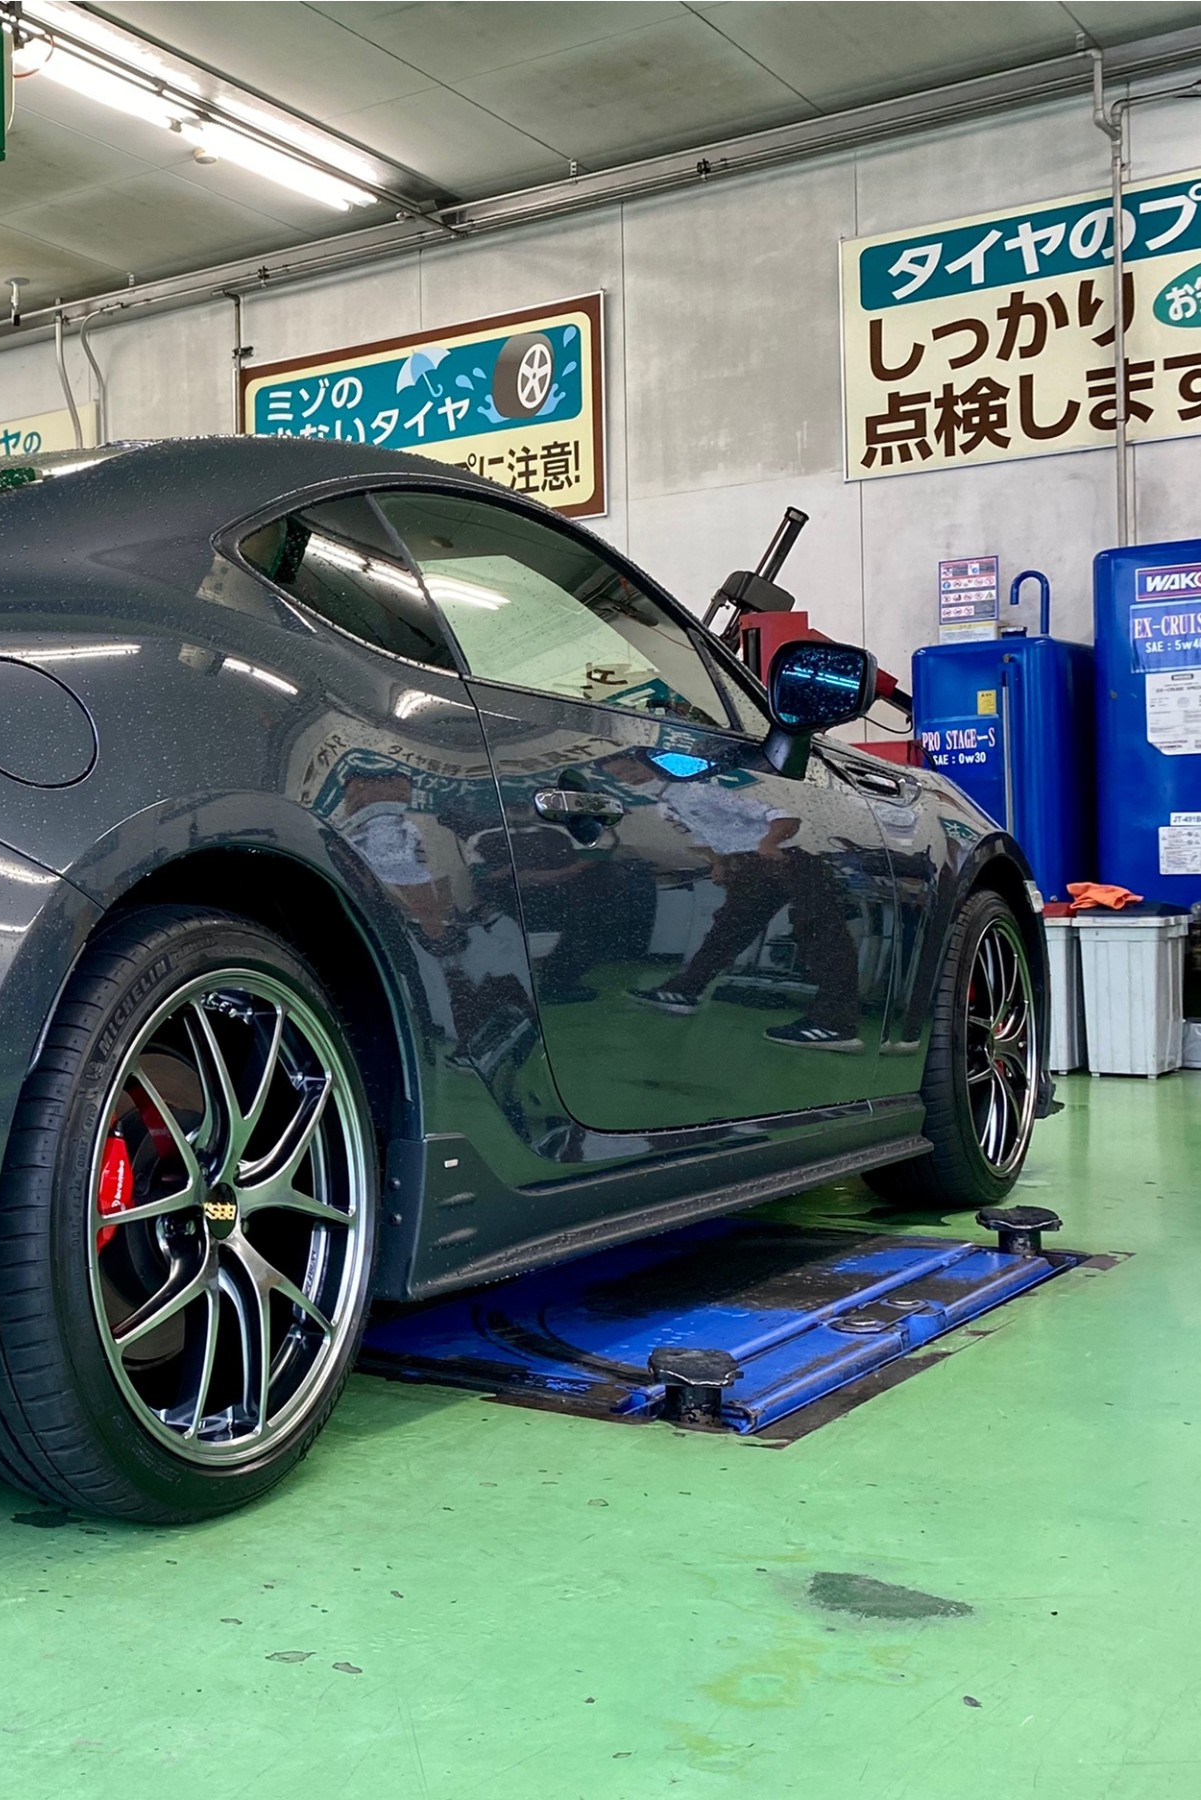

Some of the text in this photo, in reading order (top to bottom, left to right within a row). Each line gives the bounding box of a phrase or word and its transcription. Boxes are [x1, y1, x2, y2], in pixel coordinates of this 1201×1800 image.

[887, 182, 1201, 300] タイヤのプ
[1165, 277, 1201, 321] お
[869, 271, 1135, 382] しっかり
[267, 376, 363, 421] ミゾの
[1146, 641, 1164, 653] SAE
[1175, 638, 1201, 651] 5w4
[922, 731, 940, 751] PRO
[933, 754, 949, 765] SAE
[959, 751, 986, 764] 0w30
[98, 959, 169, 1056] MICHELIN
